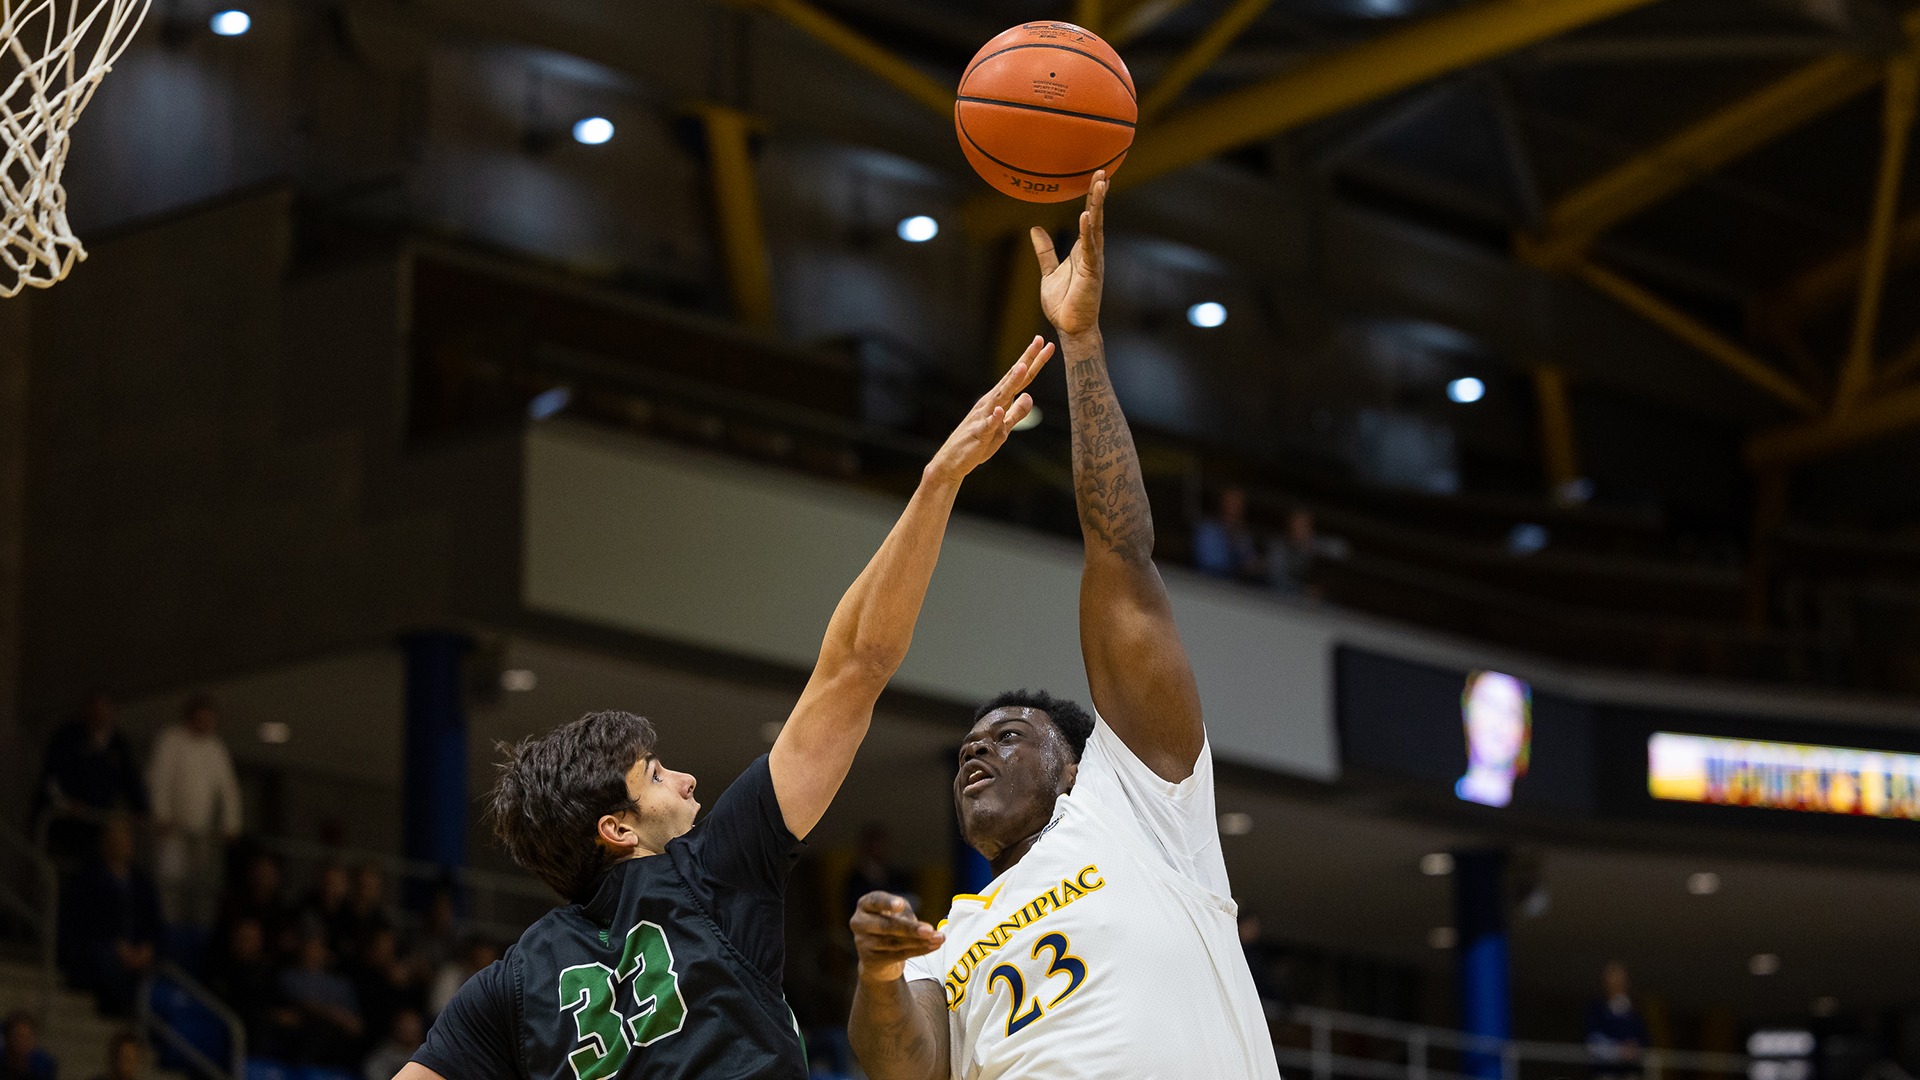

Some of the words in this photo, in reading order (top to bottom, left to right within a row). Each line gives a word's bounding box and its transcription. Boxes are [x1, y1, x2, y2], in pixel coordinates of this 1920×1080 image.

[1009, 175, 1060, 193] ROCK
[558, 919, 689, 1080] 33
[945, 864, 1106, 1012] QUINNIPIAC
[986, 930, 1089, 1038] 23
